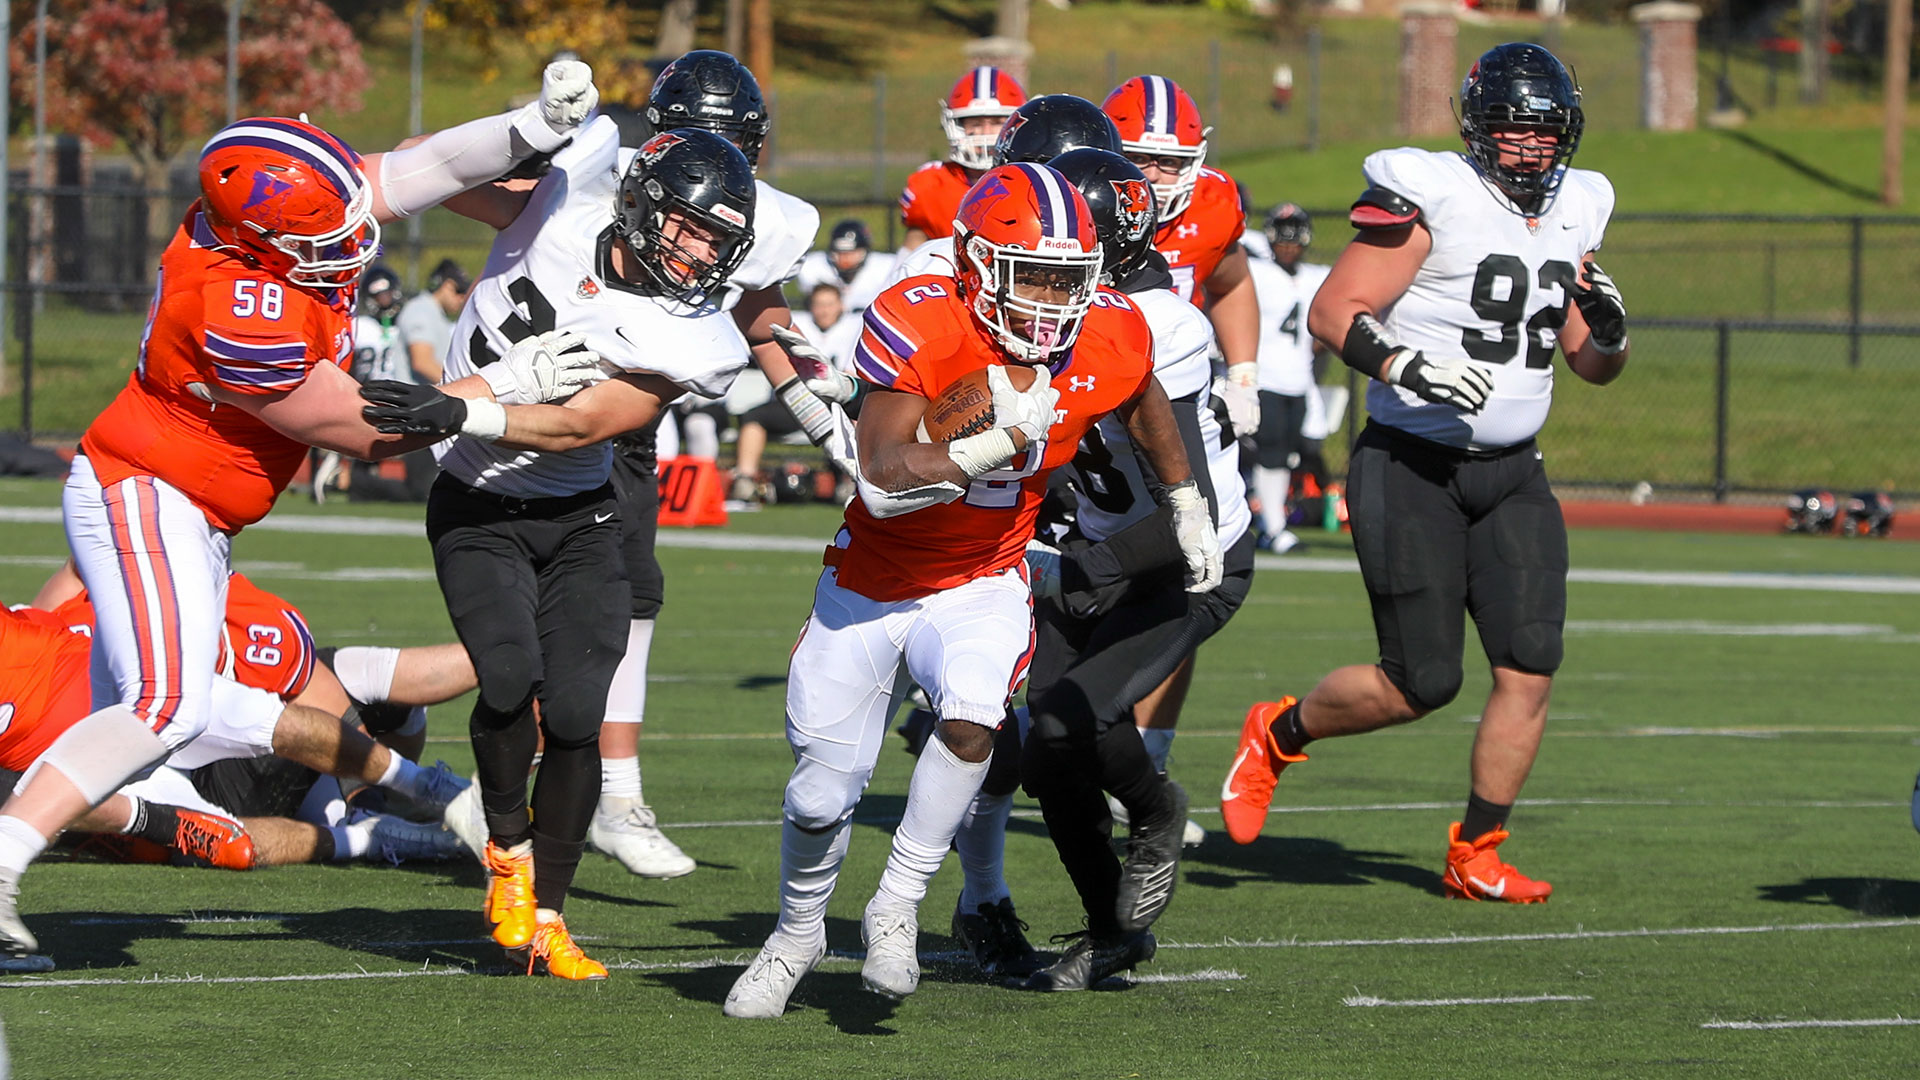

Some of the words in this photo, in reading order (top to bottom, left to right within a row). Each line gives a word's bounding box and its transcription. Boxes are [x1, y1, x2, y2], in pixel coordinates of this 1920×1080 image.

[1045, 240, 1078, 249] Riddell
[232, 278, 284, 321] 58
[903, 282, 948, 305] 2
[1092, 291, 1133, 311] 2
[1462, 253, 1576, 369] 92
[1279, 301, 1299, 346] 4
[245, 624, 282, 666] 63
